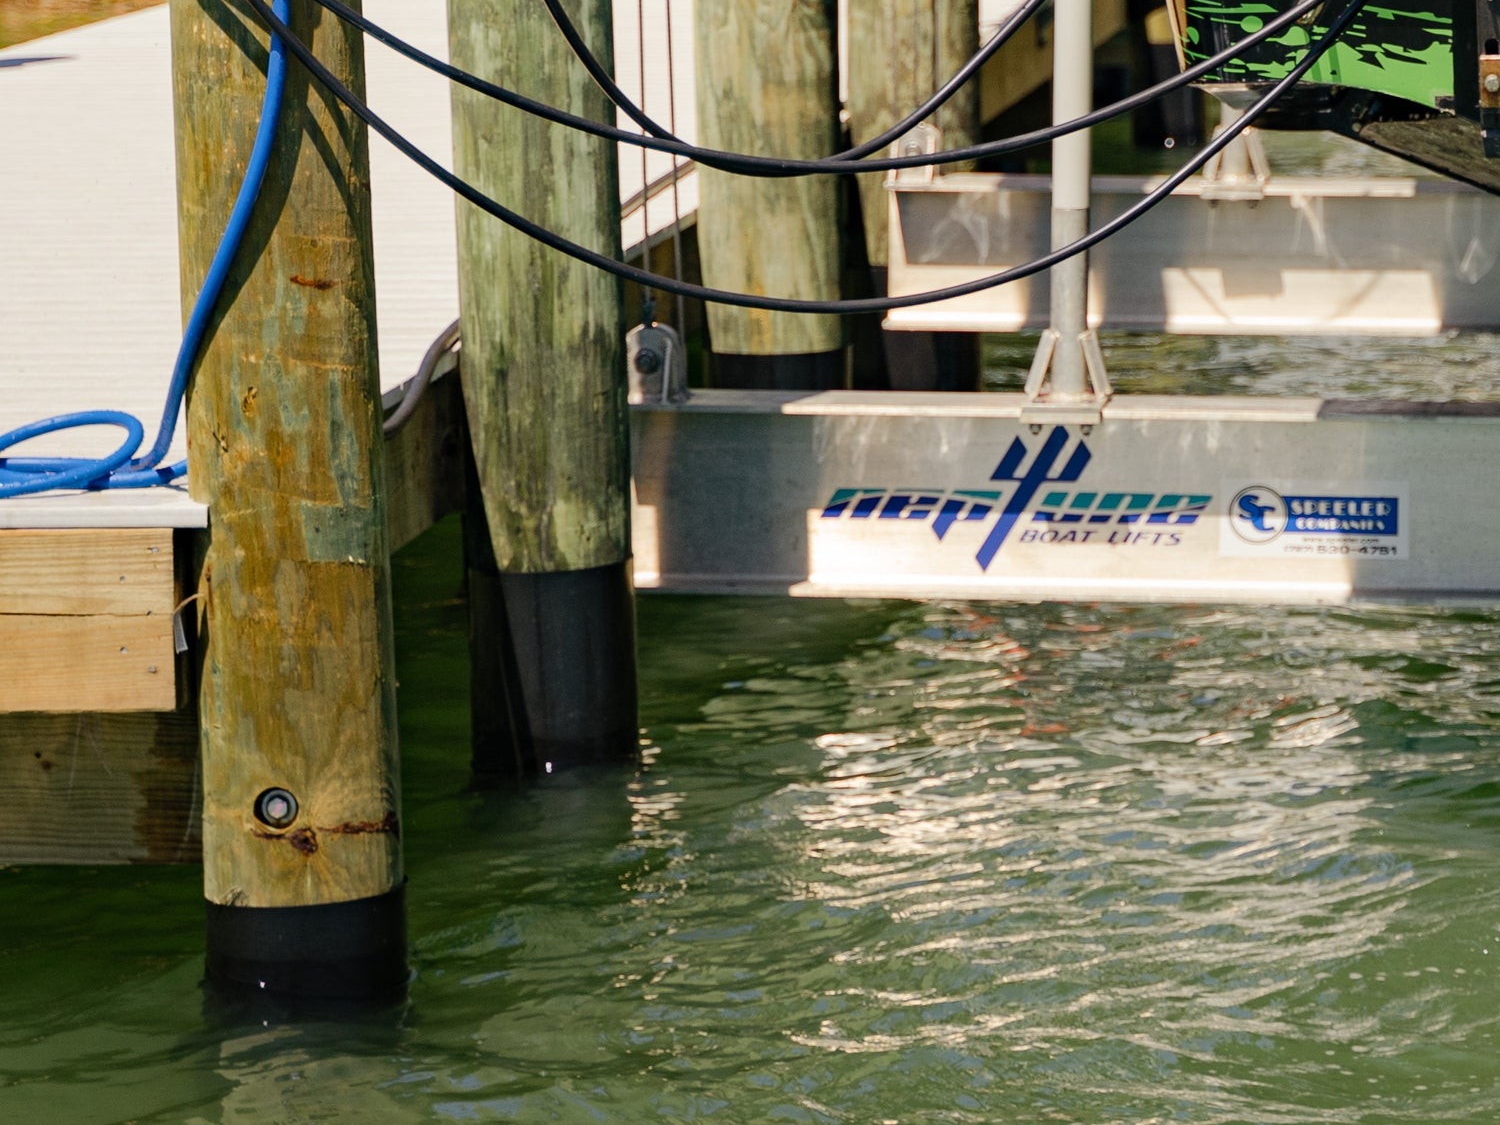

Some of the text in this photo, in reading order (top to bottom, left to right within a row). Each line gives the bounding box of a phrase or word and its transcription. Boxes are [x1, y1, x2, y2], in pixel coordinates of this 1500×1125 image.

[1290, 499, 1392, 516] SPEELER
[1019, 530, 1183, 546] BOAT LIFTS
